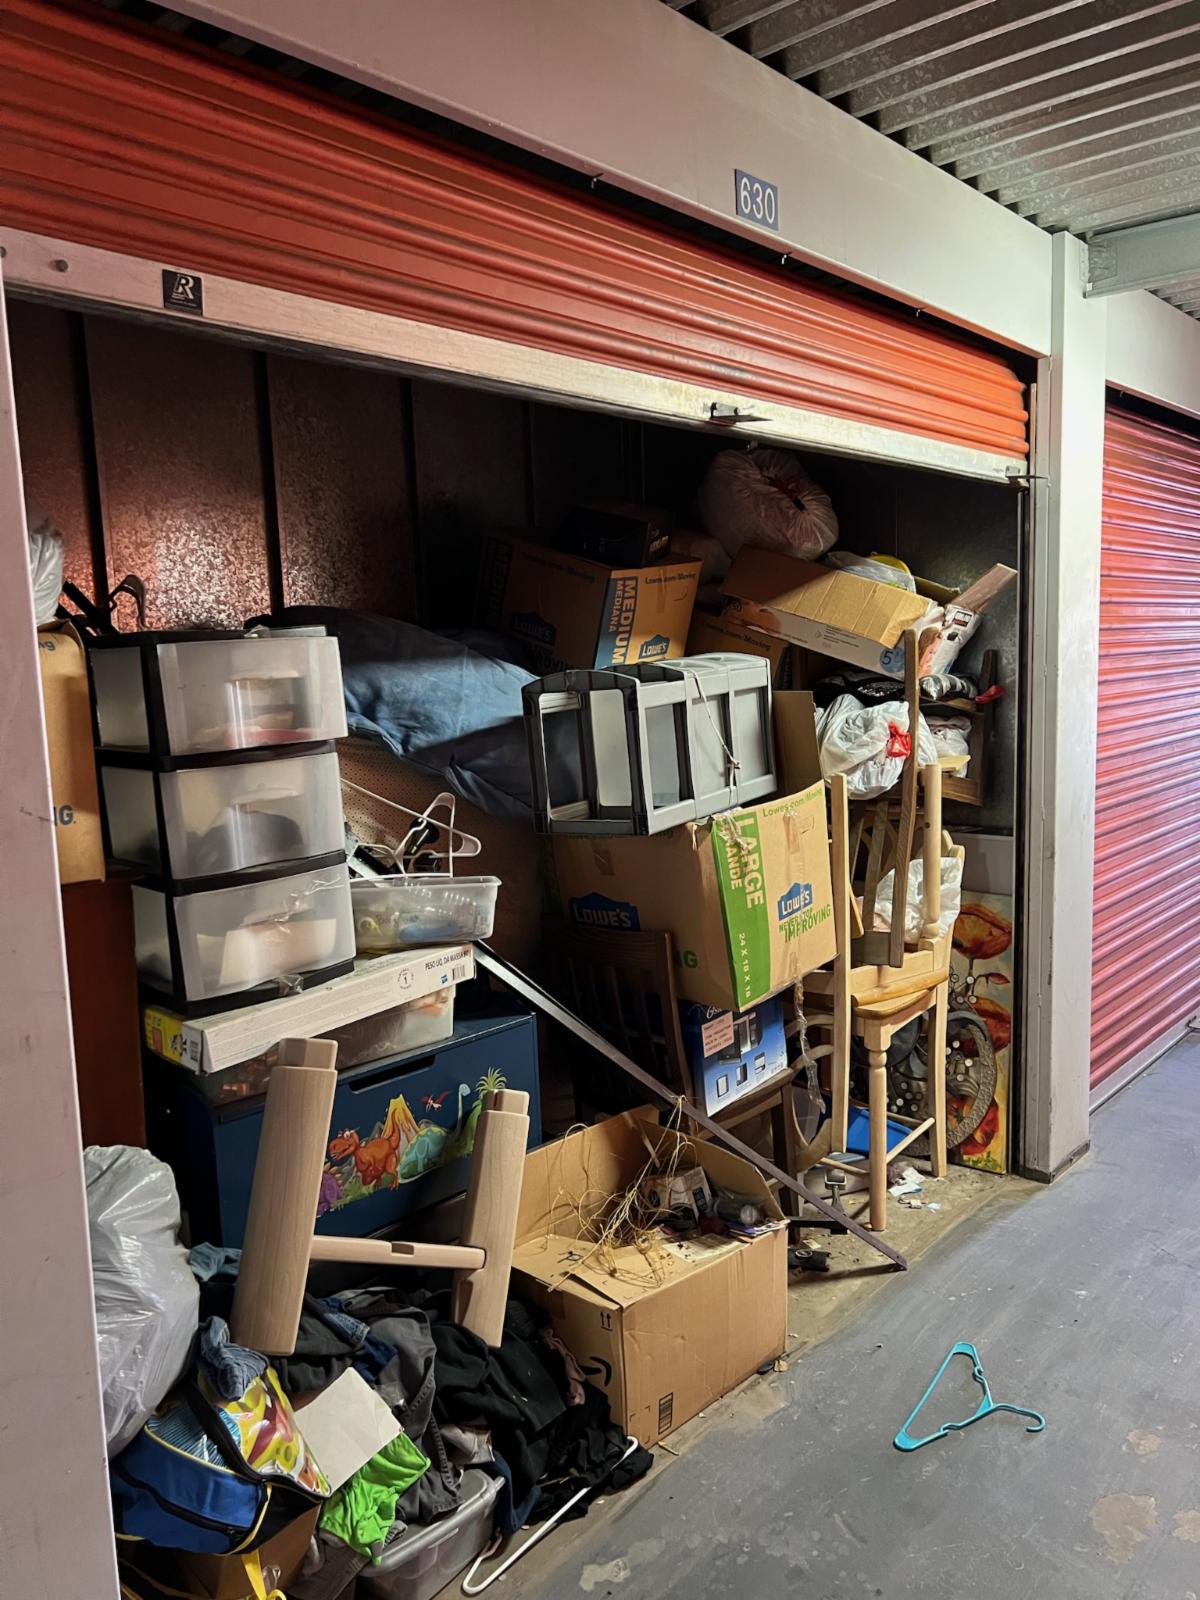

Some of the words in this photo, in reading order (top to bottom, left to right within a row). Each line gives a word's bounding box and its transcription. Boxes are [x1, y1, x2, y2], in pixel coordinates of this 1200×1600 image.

[741, 177, 776, 224] 630
[608, 580, 624, 633] MEDIANA
[612, 579, 637, 664] MEDIUM
[735, 817, 765, 909] LARGE
[574, 903, 632, 928] LOWE'S
[785, 903, 831, 943] IMPROVING
